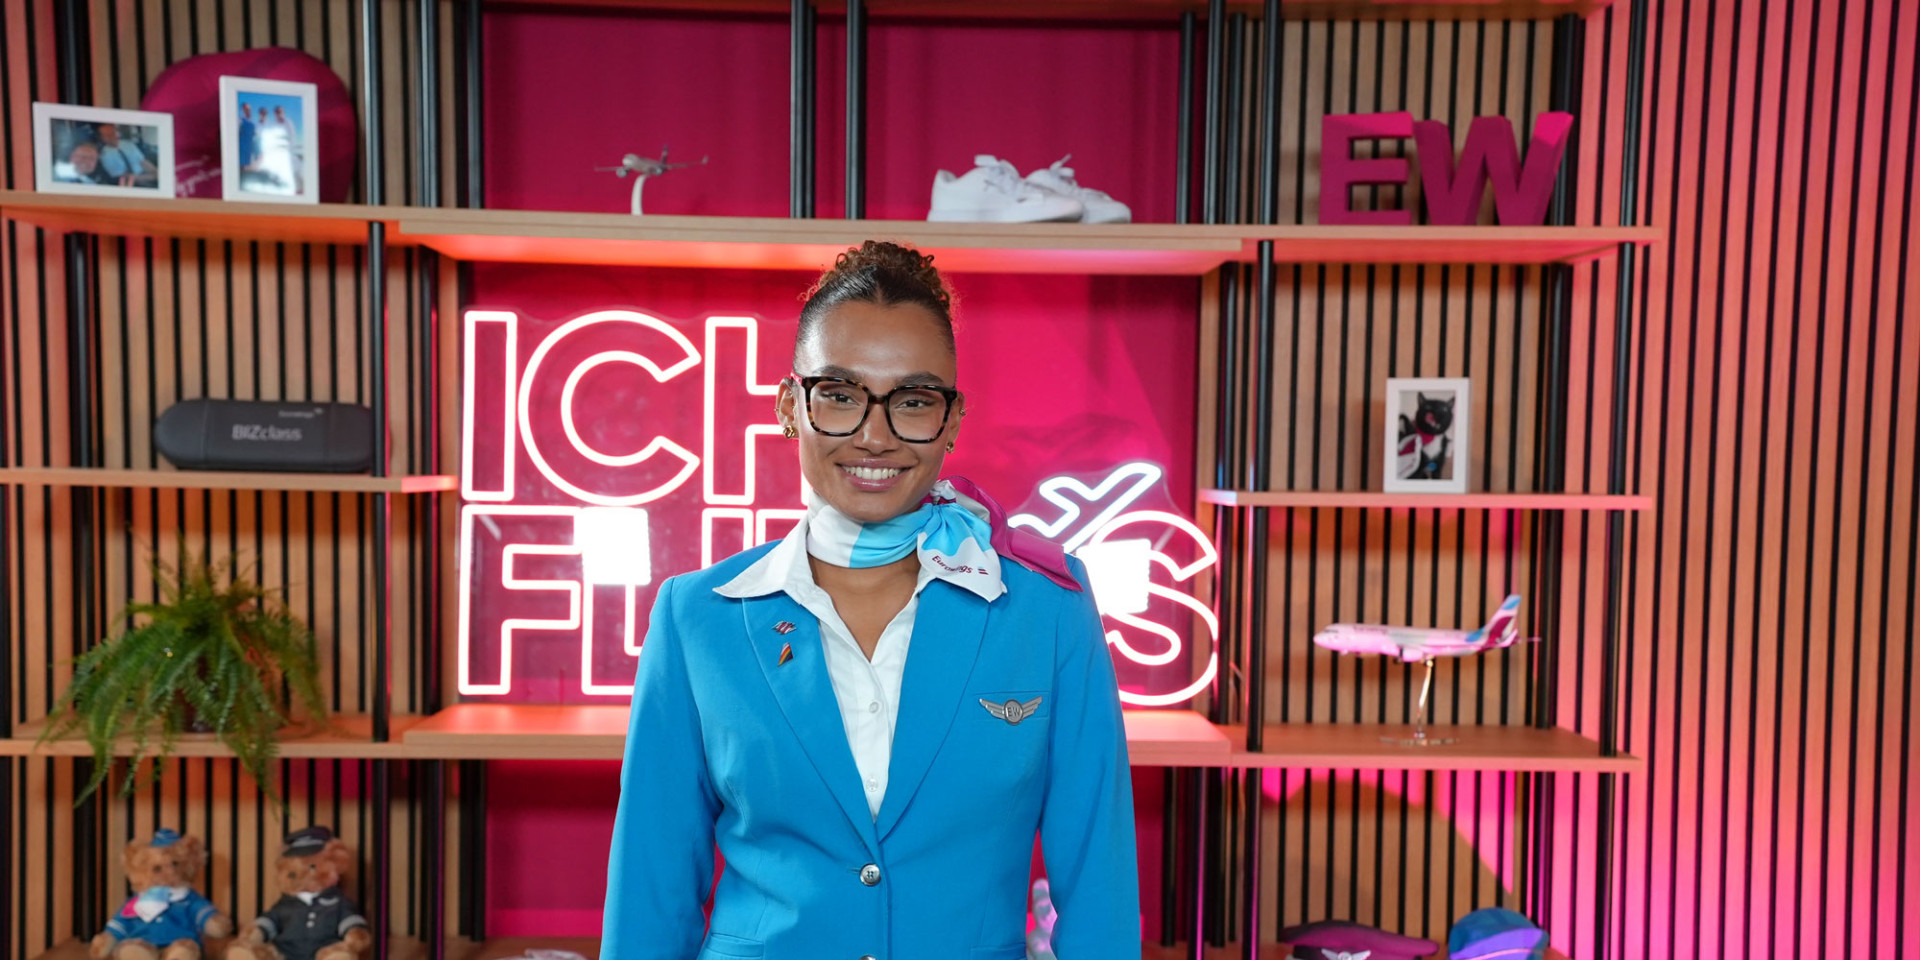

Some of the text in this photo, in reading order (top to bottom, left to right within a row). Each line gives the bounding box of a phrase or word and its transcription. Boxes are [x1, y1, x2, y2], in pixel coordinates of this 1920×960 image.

[1319, 111, 1574, 226] EW
[932, 555, 973, 573] Eurowgs
[1007, 706, 1021, 717] EW
